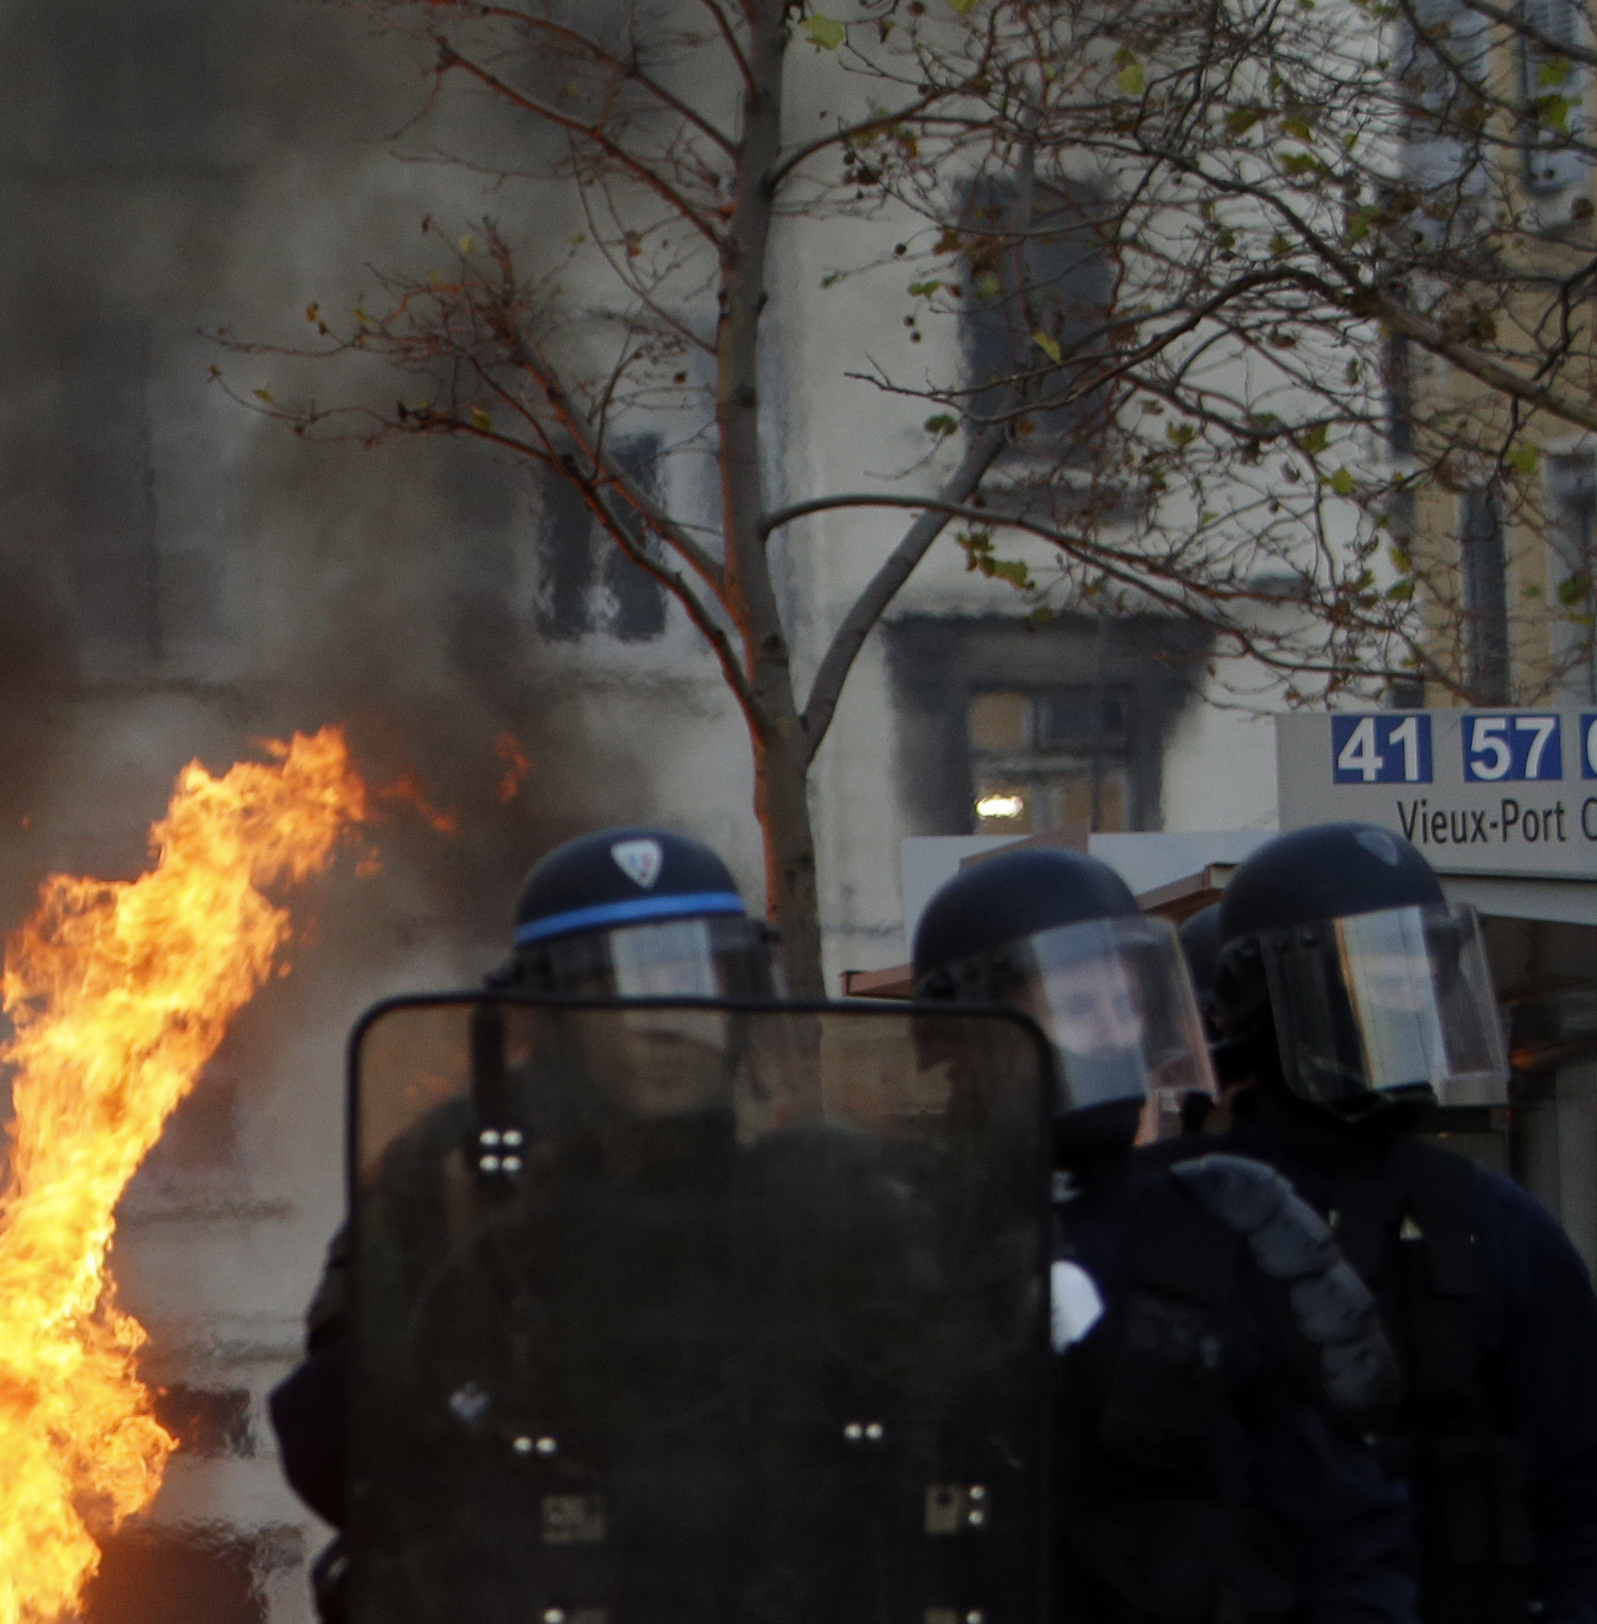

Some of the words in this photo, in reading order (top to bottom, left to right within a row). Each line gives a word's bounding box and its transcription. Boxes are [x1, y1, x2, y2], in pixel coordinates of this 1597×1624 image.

[1337, 716, 1419, 782] 41
[1469, 716, 1556, 780] 57
[1396, 798, 1568, 846] Vieux-Port
